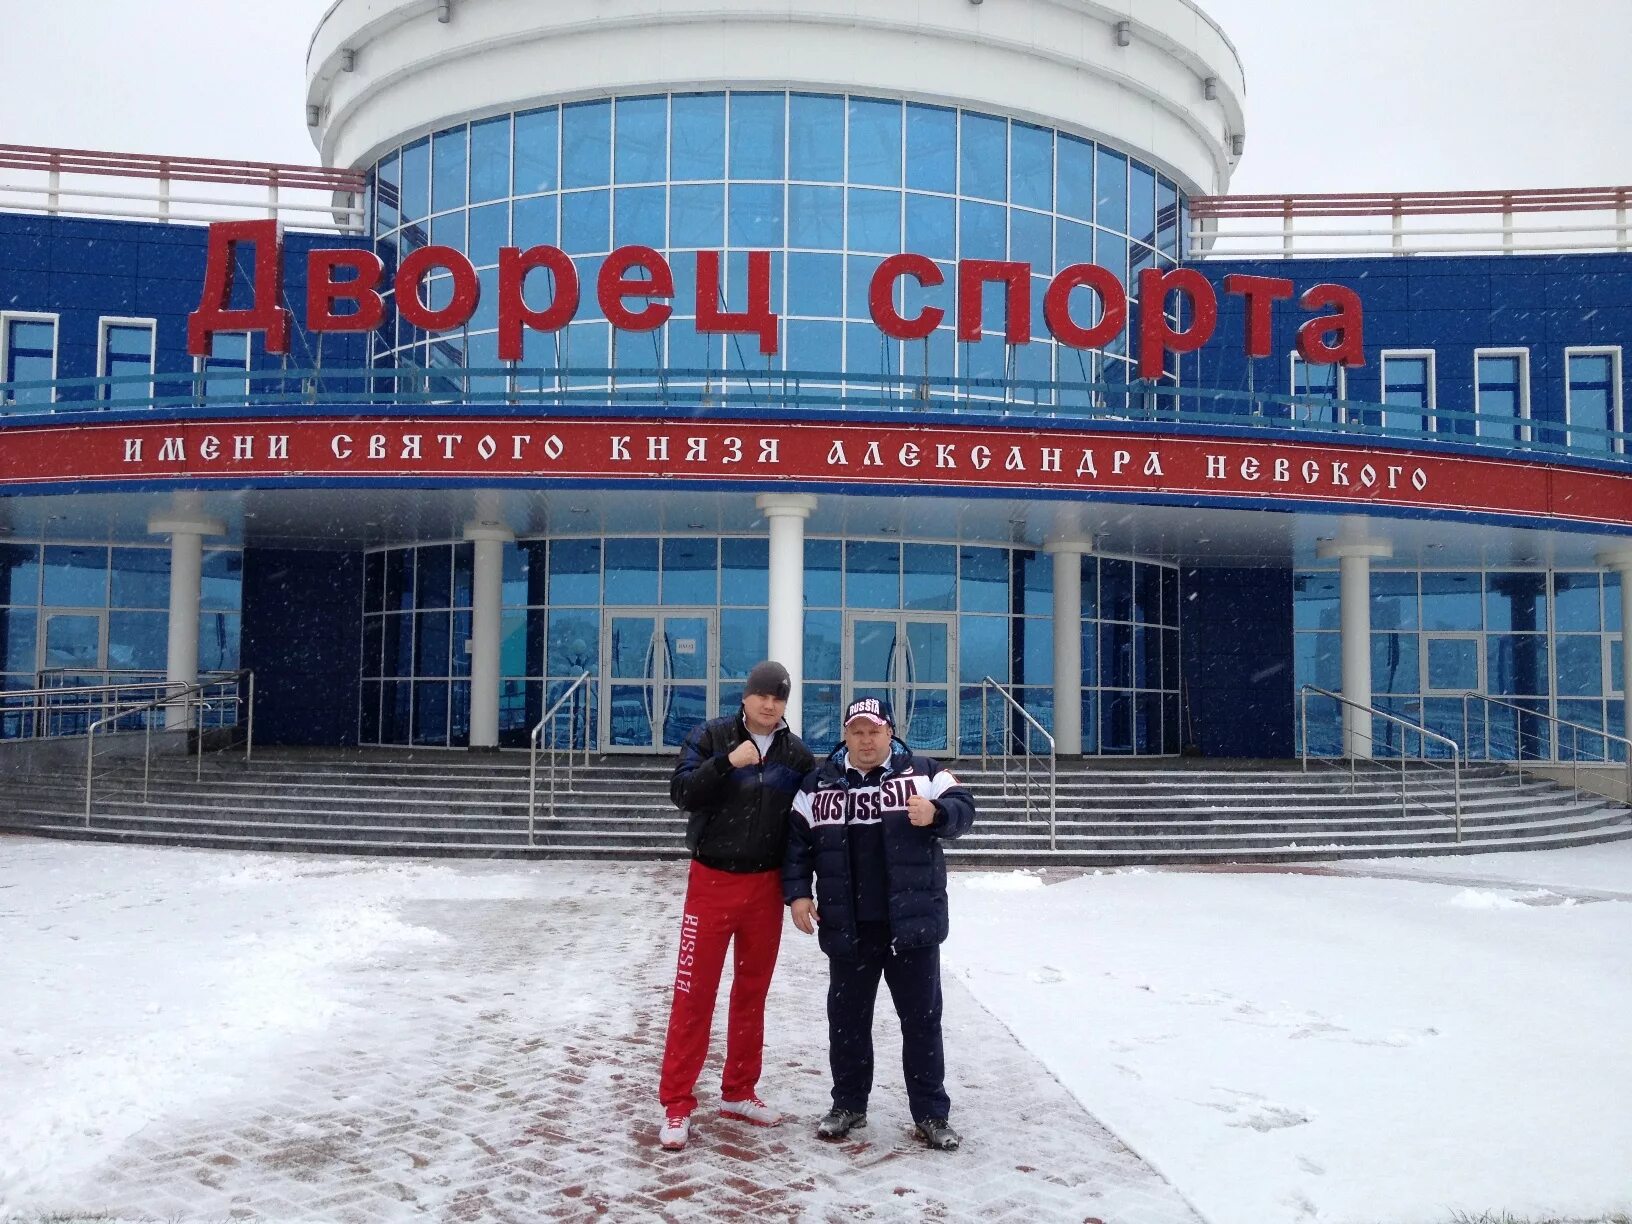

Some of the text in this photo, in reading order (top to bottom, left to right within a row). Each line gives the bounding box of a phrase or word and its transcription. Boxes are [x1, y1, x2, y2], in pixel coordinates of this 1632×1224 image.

[187, 218, 1366, 379] Дворец спорта
[123, 434, 1427, 491] ИМЕНИ СВЯТОГО КНЯЗЯ АЛЕКСАНДРА НЕВСКОГО
[849, 700, 880, 716] RUSSIA
[677, 913, 699, 994] RUSSIA
